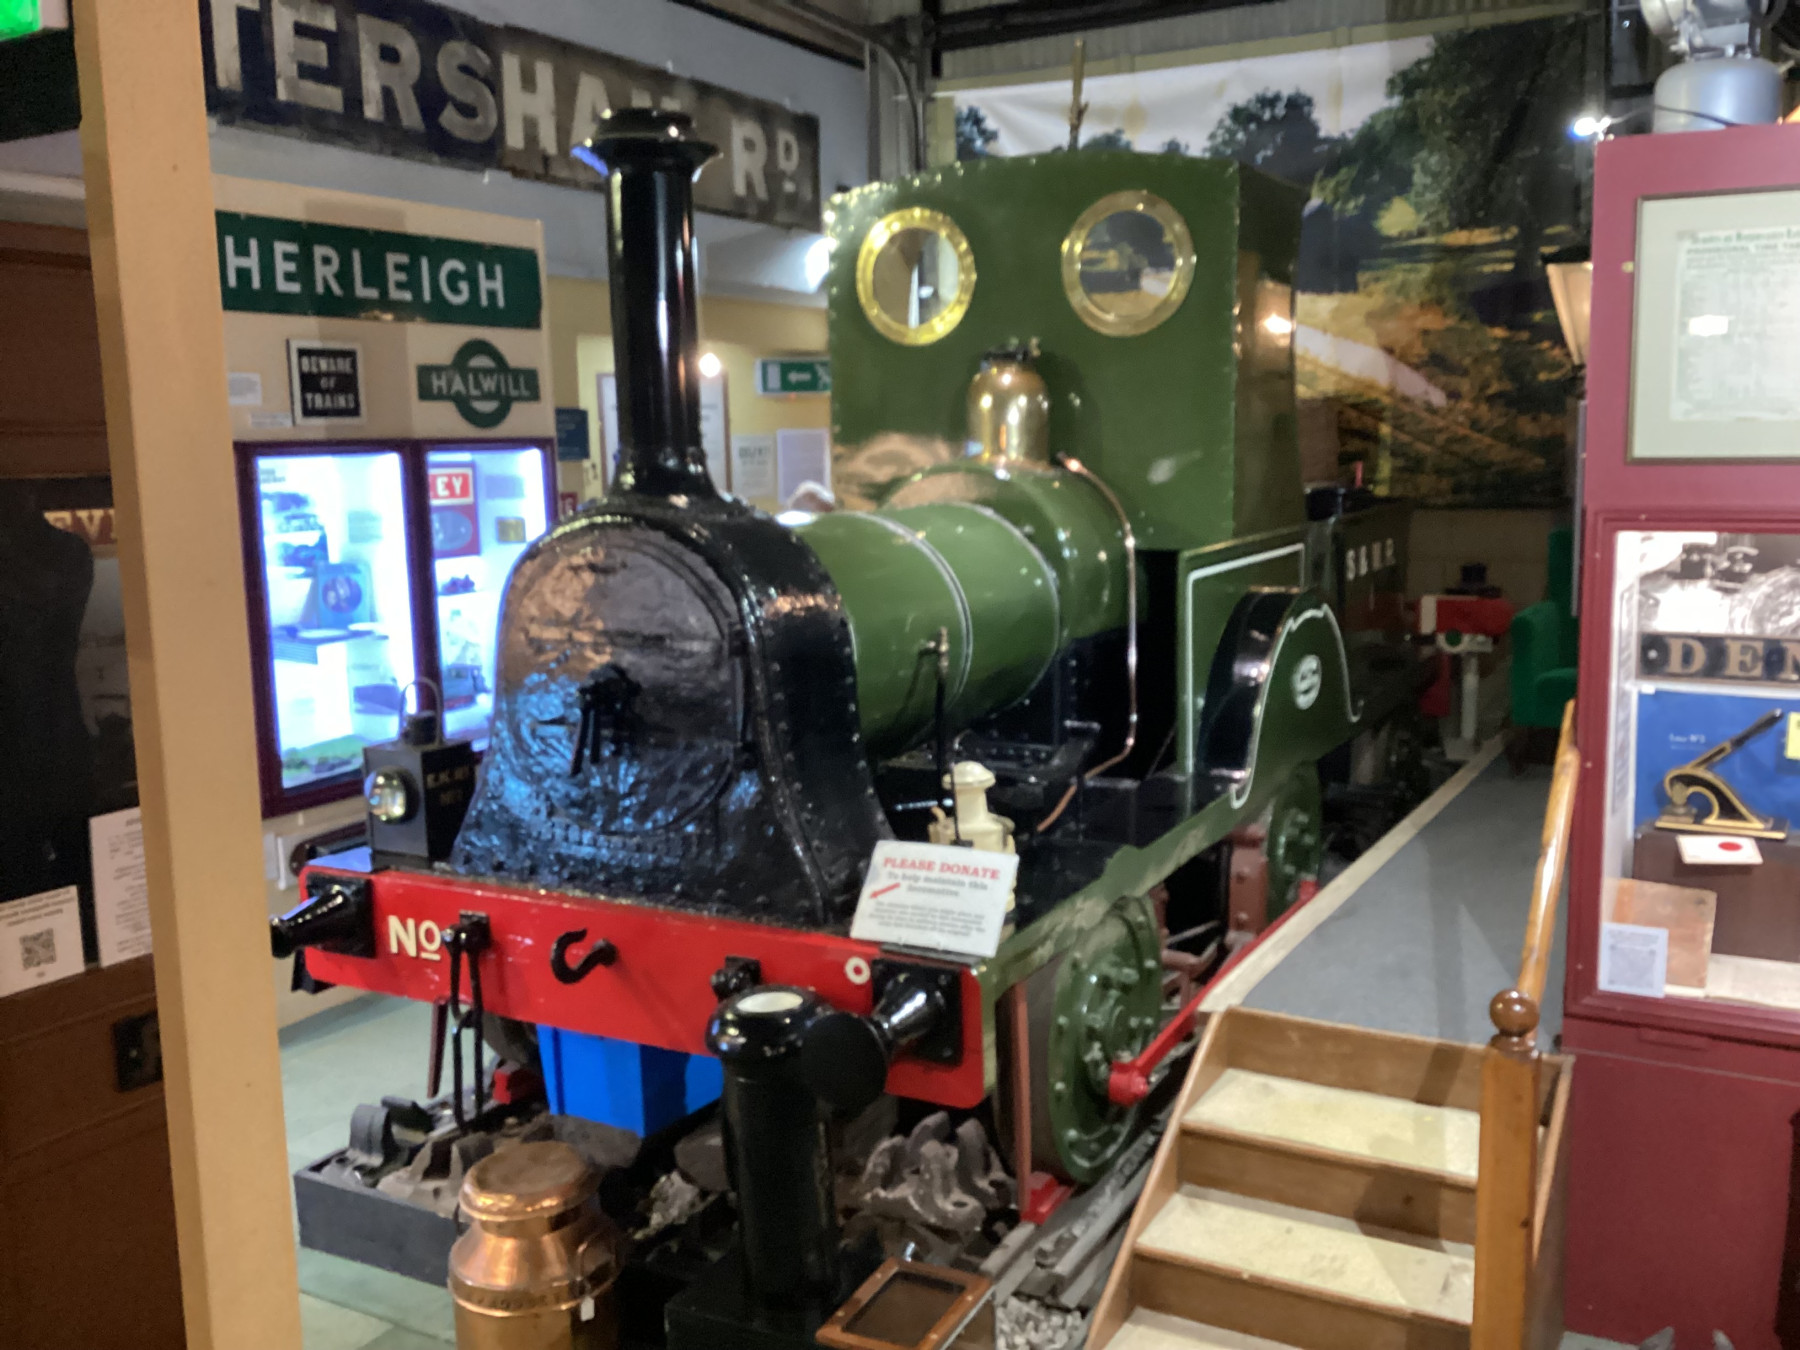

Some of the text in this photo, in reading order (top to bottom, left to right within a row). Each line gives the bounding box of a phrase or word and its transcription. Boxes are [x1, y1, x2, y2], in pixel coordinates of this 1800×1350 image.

[209, 0, 683, 156] TERSHA
[224, 235, 506, 309] HERLEIGH
[301, 355, 353, 374] BEWARE
[320, 376, 336, 390] OF
[431, 370, 531, 397] HALWILL
[305, 392, 355, 410] TRAINS
[429, 475, 463, 498] EY
[883, 857, 1001, 880] PLEASE DONATE
[901, 873, 922, 884] help
[923, 875, 966, 888] maintain
[968, 878, 988, 891] this
